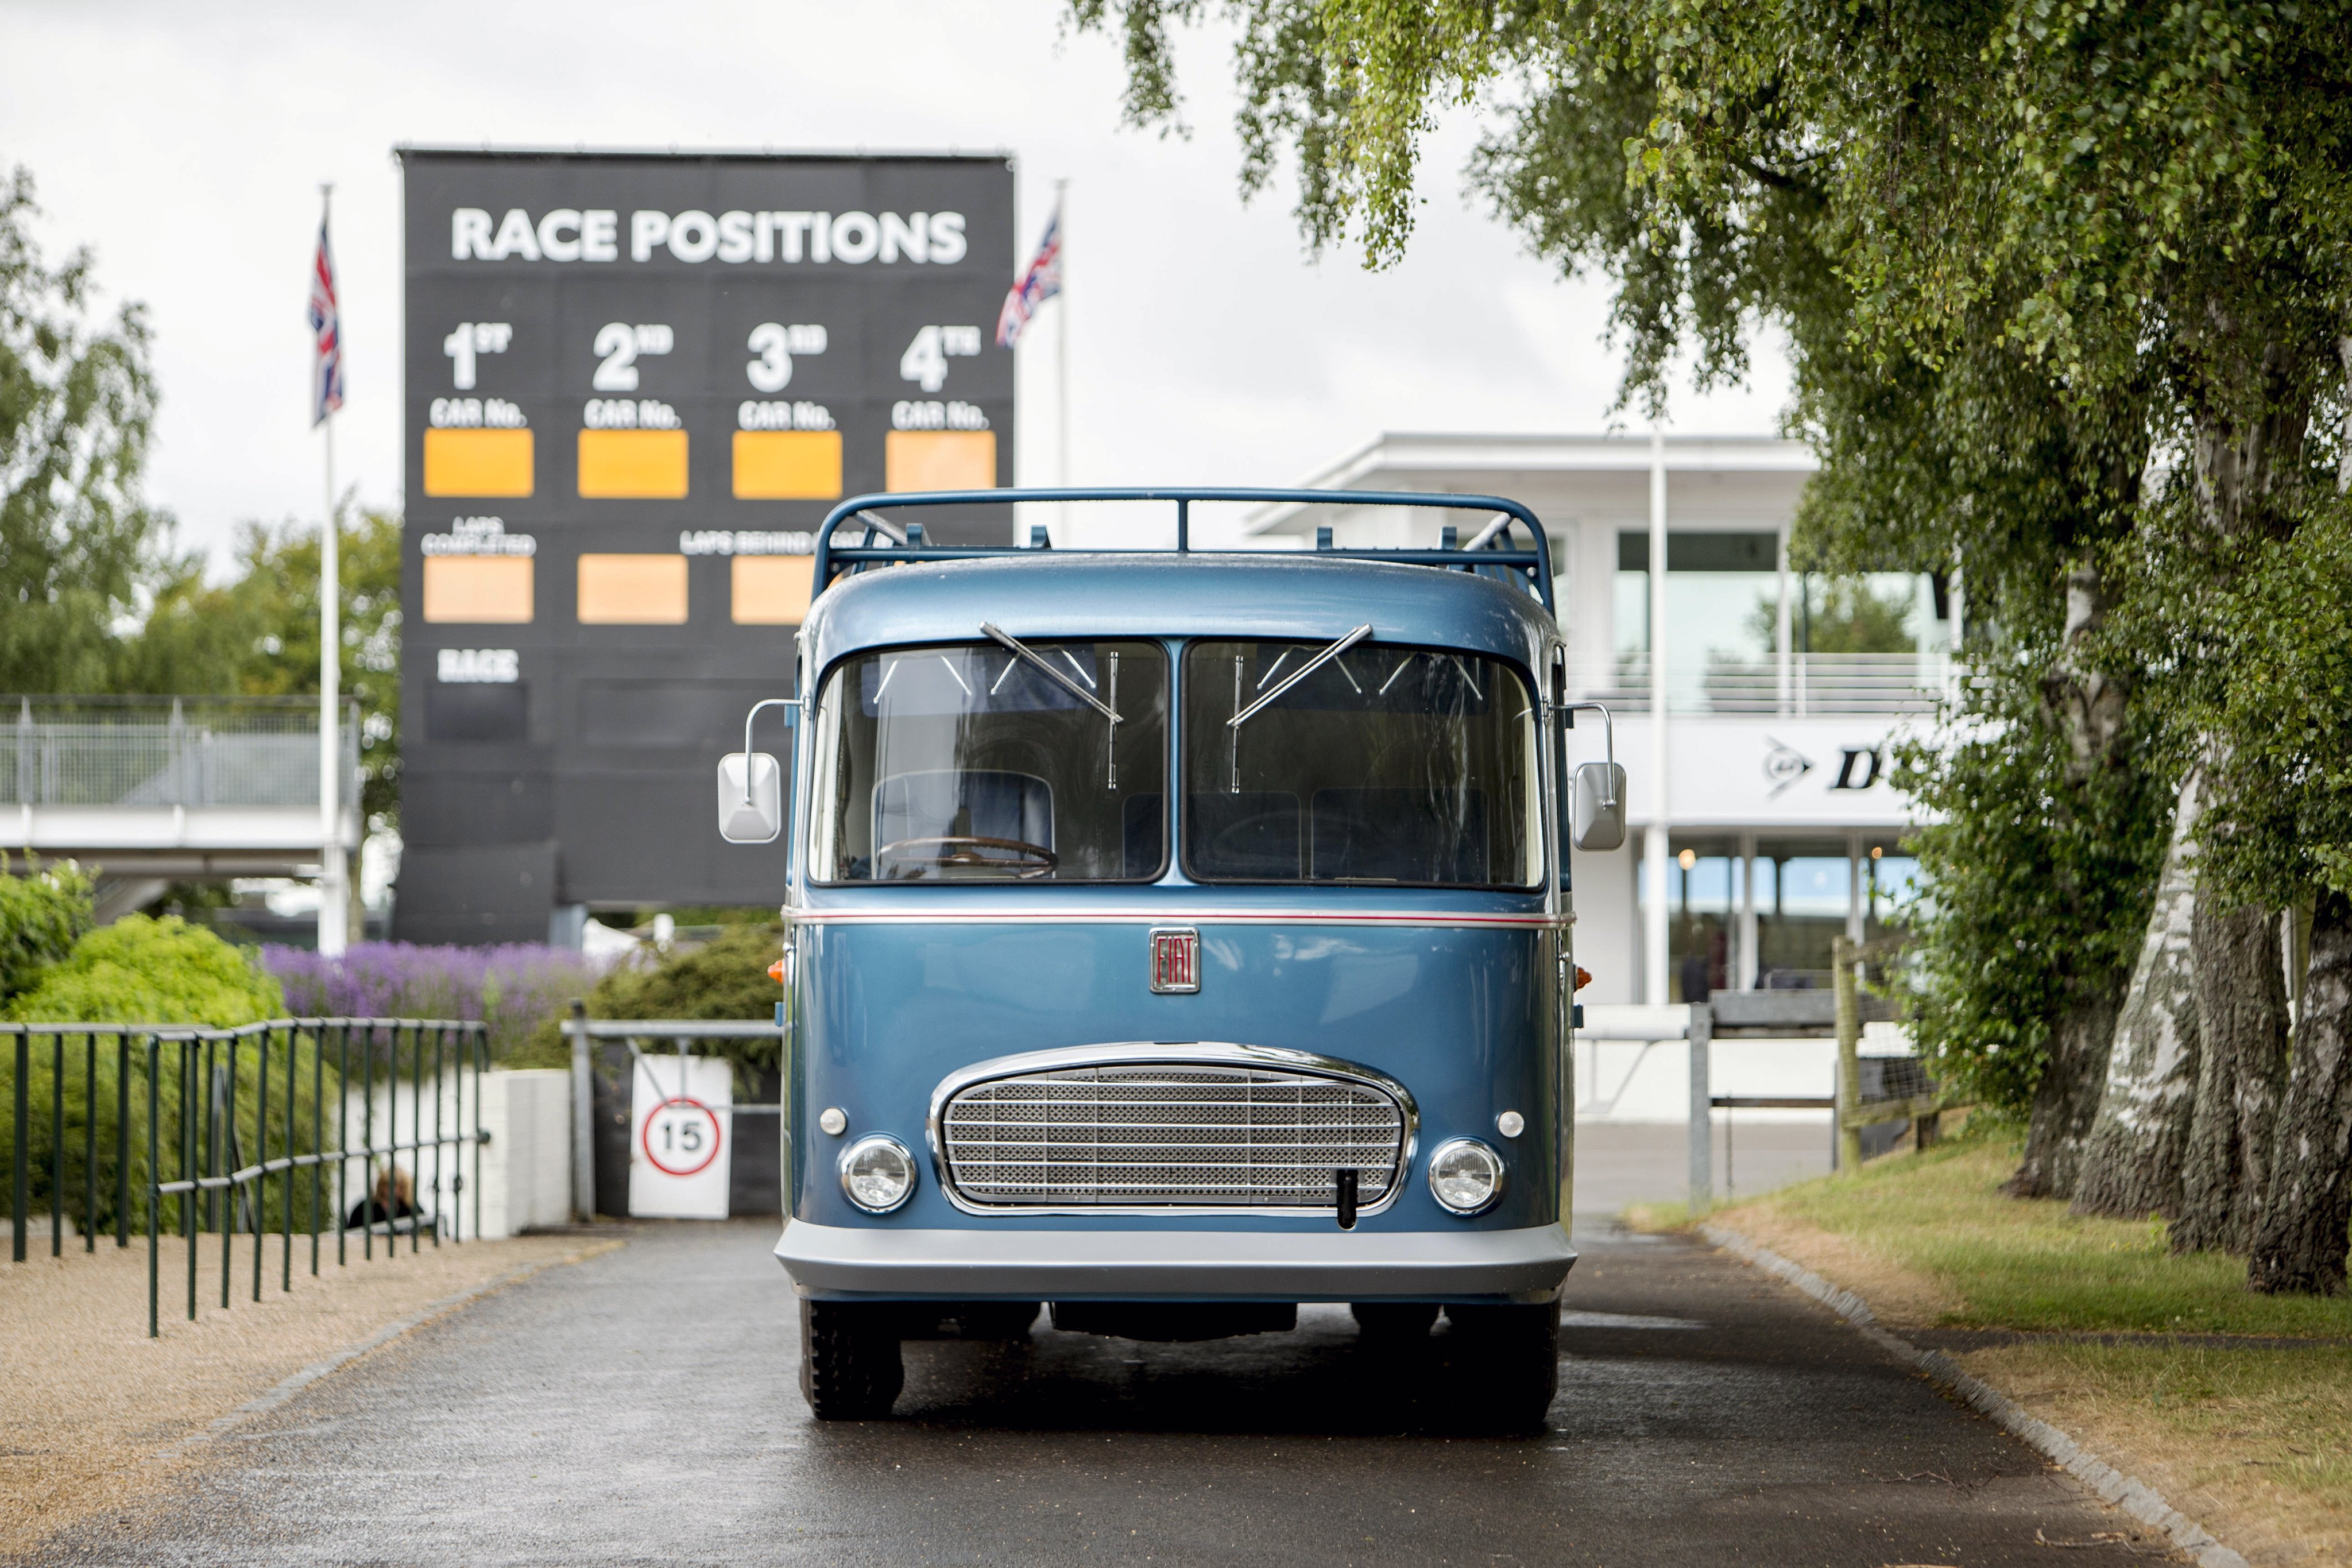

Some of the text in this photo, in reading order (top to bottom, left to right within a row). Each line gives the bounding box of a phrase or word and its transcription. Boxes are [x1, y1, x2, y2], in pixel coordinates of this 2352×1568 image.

[452, 208, 967, 264] RACE POSITIONS
[1156, 936, 1194, 983] FIAT
[661, 1121, 702, 1152] 15
